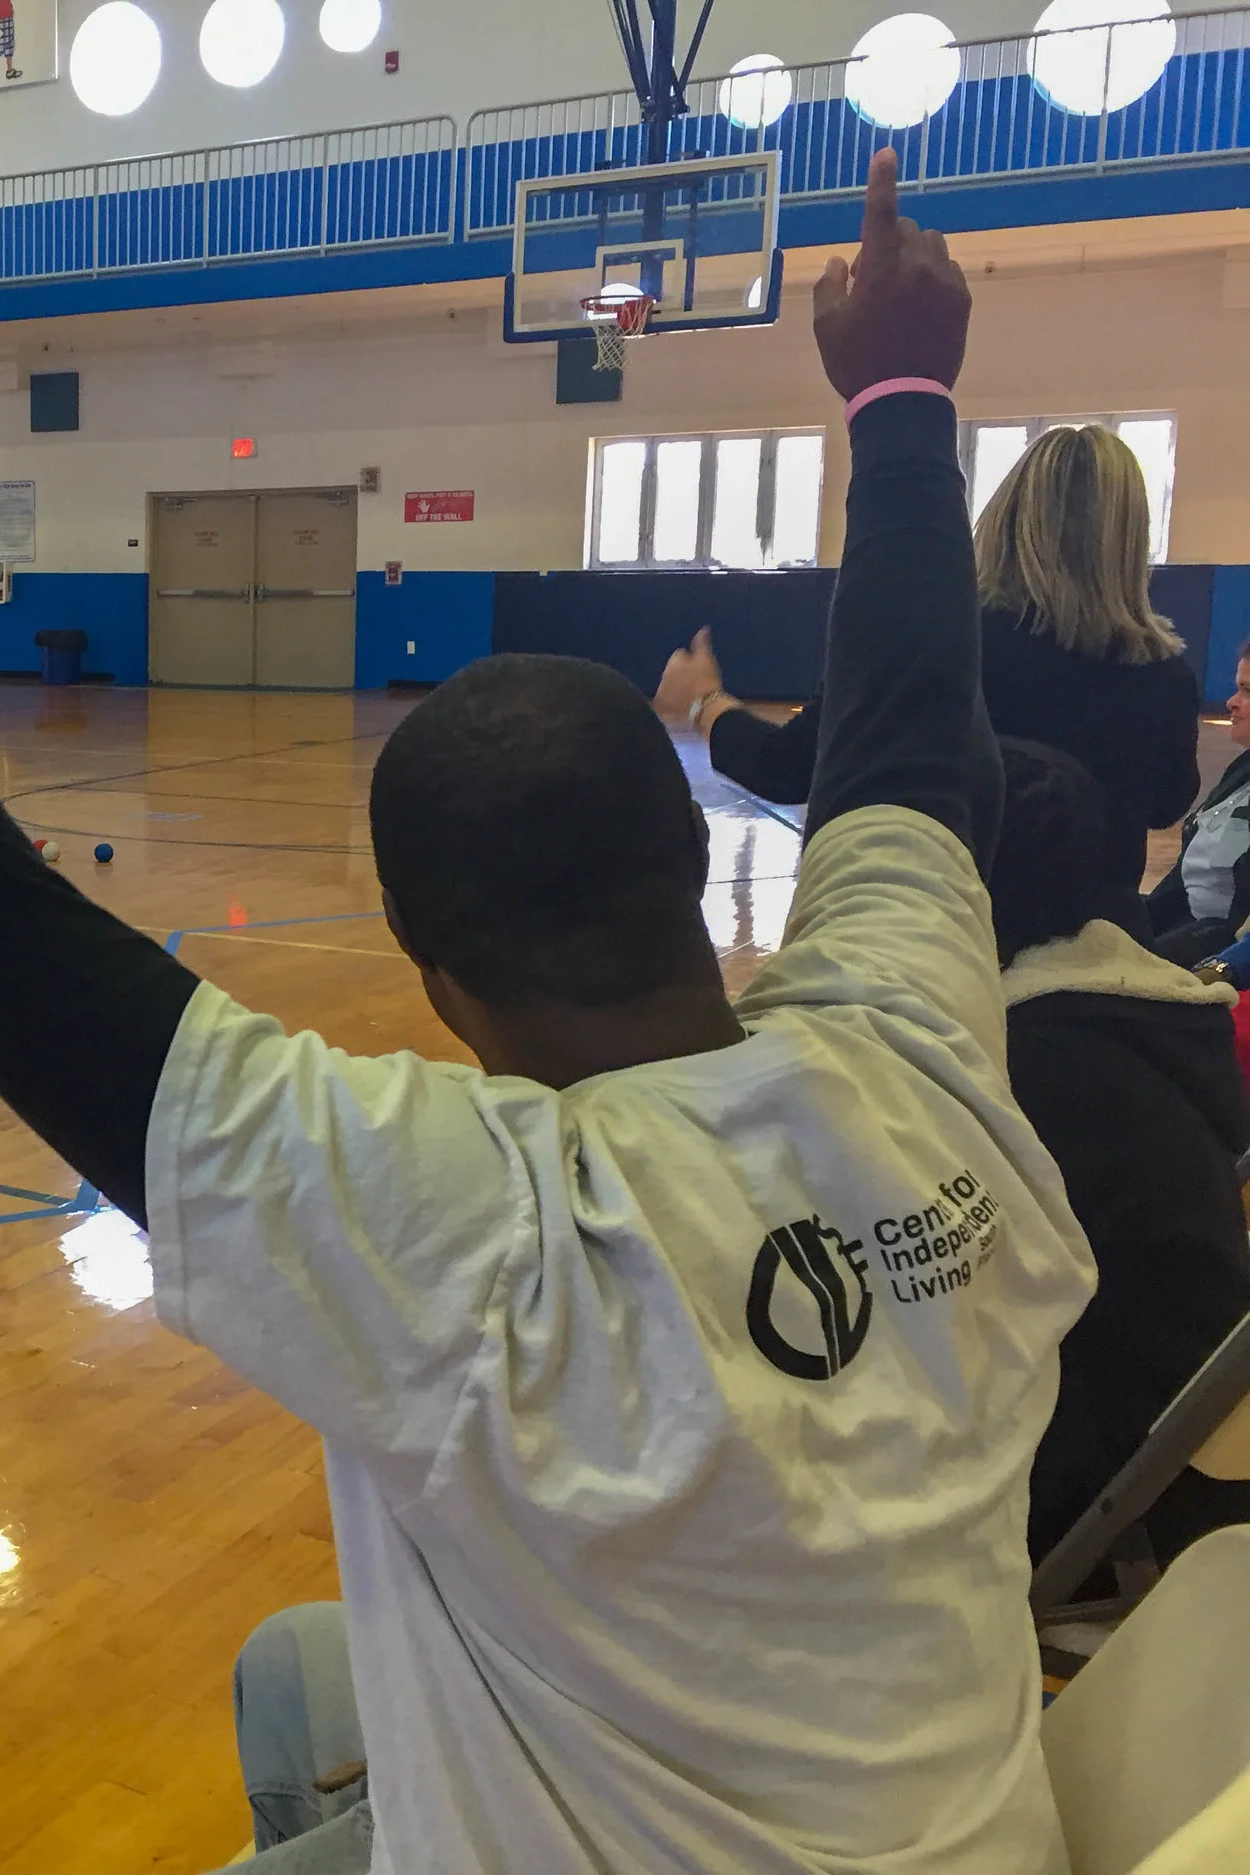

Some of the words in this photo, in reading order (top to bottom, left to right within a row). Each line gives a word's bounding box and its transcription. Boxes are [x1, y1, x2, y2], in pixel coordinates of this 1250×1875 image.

[415, 513, 429, 521] OFF
[430, 513, 442, 521] THE
[443, 512, 462, 520] WALL
[891, 1260, 972, 1303] Living
